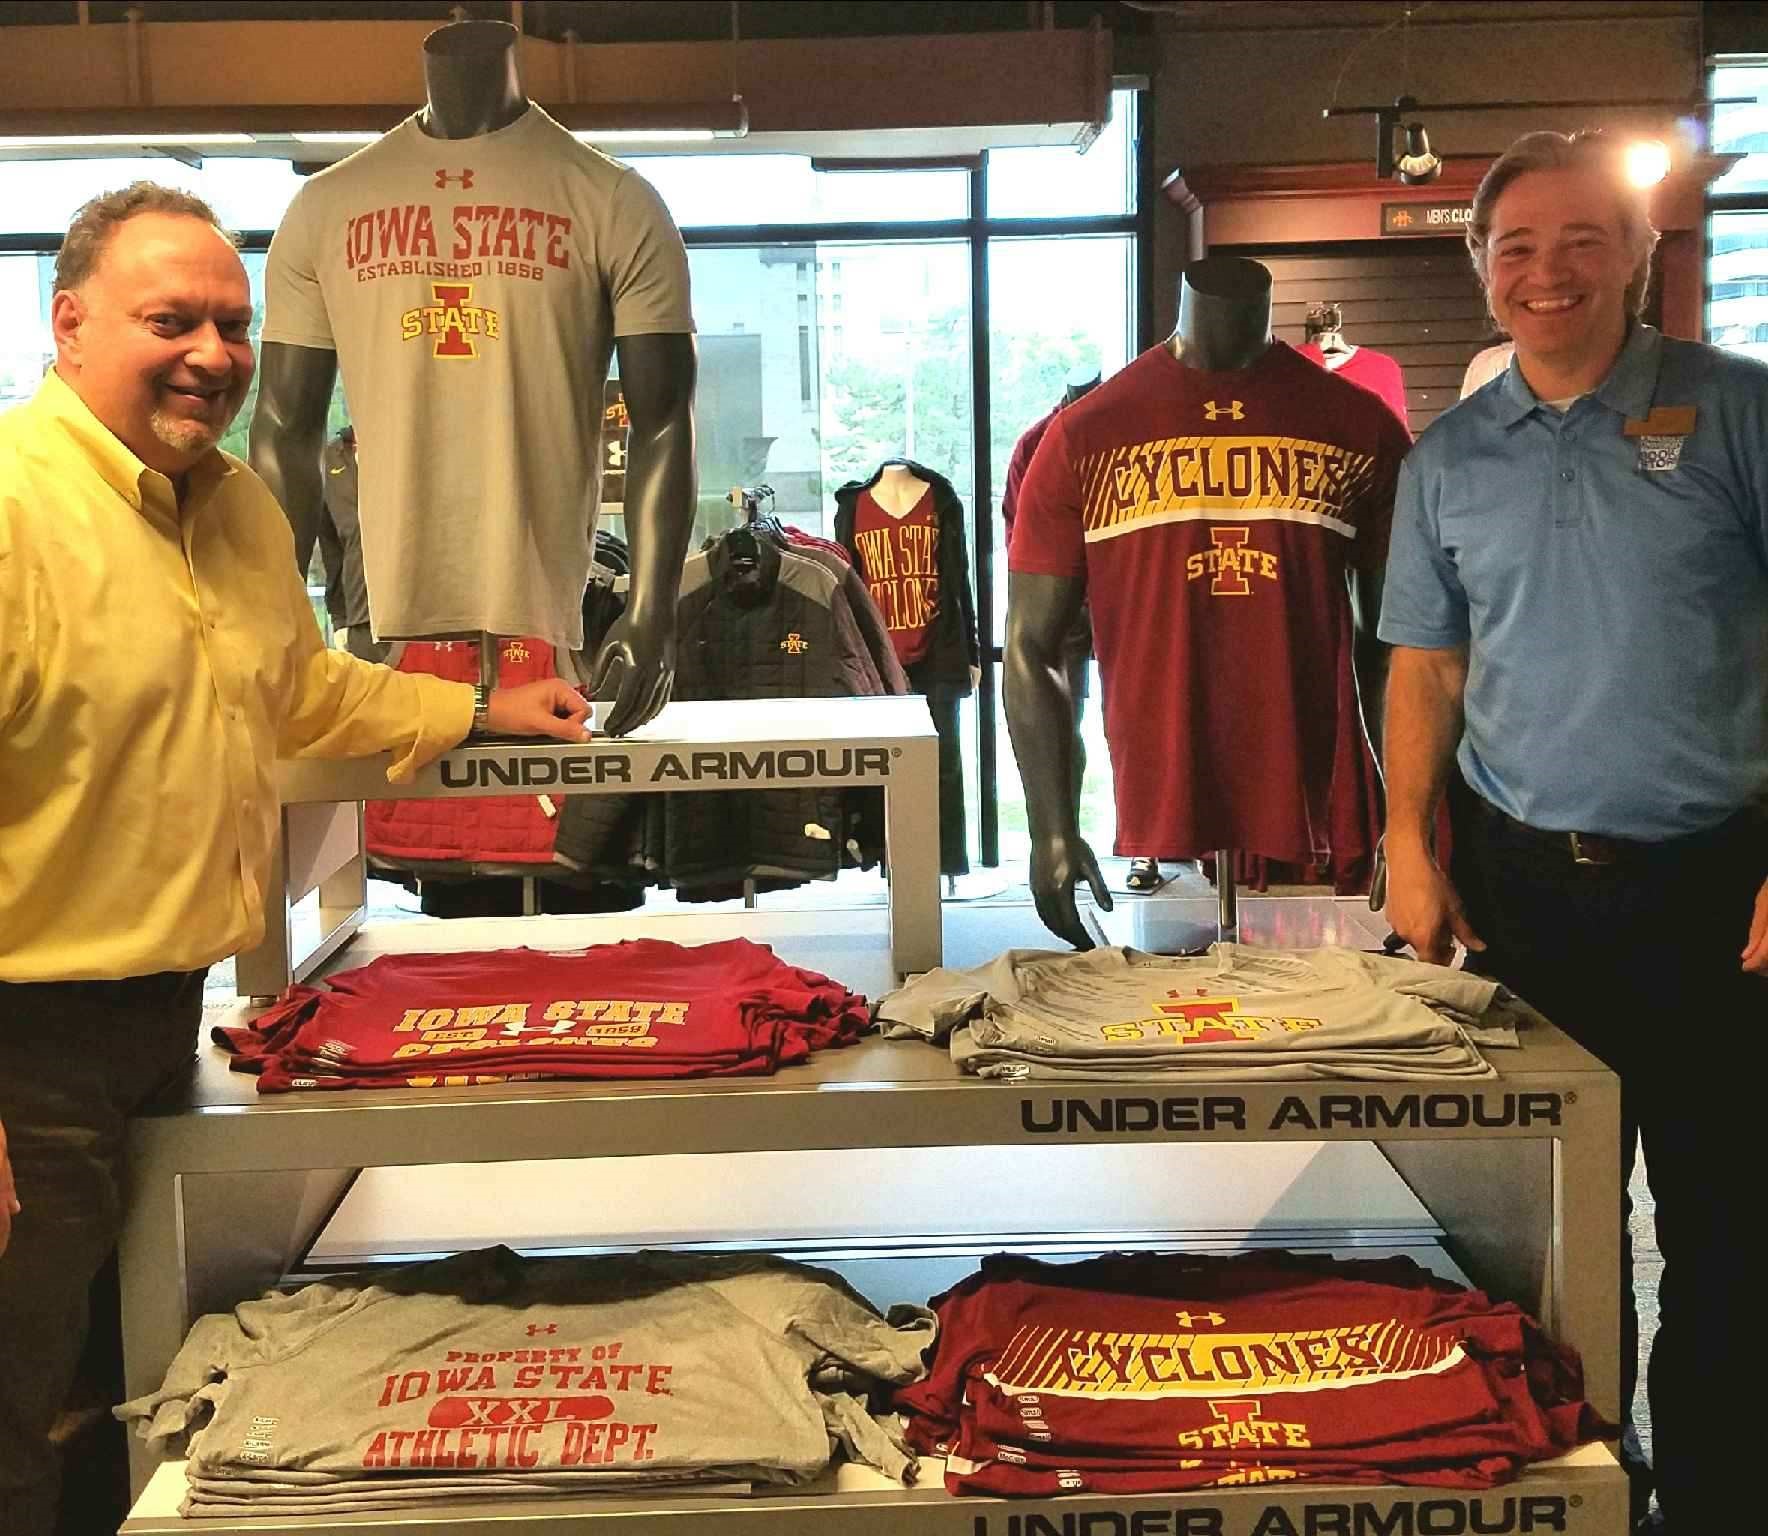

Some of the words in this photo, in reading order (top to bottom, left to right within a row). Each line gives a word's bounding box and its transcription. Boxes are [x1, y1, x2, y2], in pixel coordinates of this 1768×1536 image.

[346, 205, 438, 269] IOWA
[453, 205, 572, 269] STATE
[357, 260, 482, 282] ESTABLISHED
[497, 261, 544, 281] 1858
[401, 306, 499, 341] STATE
[1108, 444, 1349, 510] CYCLONES
[1186, 547, 1279, 581] STATE
[440, 754, 632, 787] UNDER
[393, 1003, 531, 1032] IOWA
[543, 1000, 691, 1026] STATE
[1101, 1014, 1323, 1042] STATE
[1020, 1096, 1247, 1133] UNDER
[445, 1347, 582, 1363] PROPERTY
[591, 1342, 624, 1361] OF
[1060, 1331, 1388, 1385] CYCLONES
[378, 1365, 497, 1409] IOWA
[512, 1363, 674, 1396] STATE
[459, 1399, 577, 1427] XXL
[362, 1423, 544, 1469] ATHLETIC
[559, 1422, 659, 1467] DEPT.
[1178, 1420, 1312, 1449] STATE
[974, 1507, 1223, 1536] UNDER
